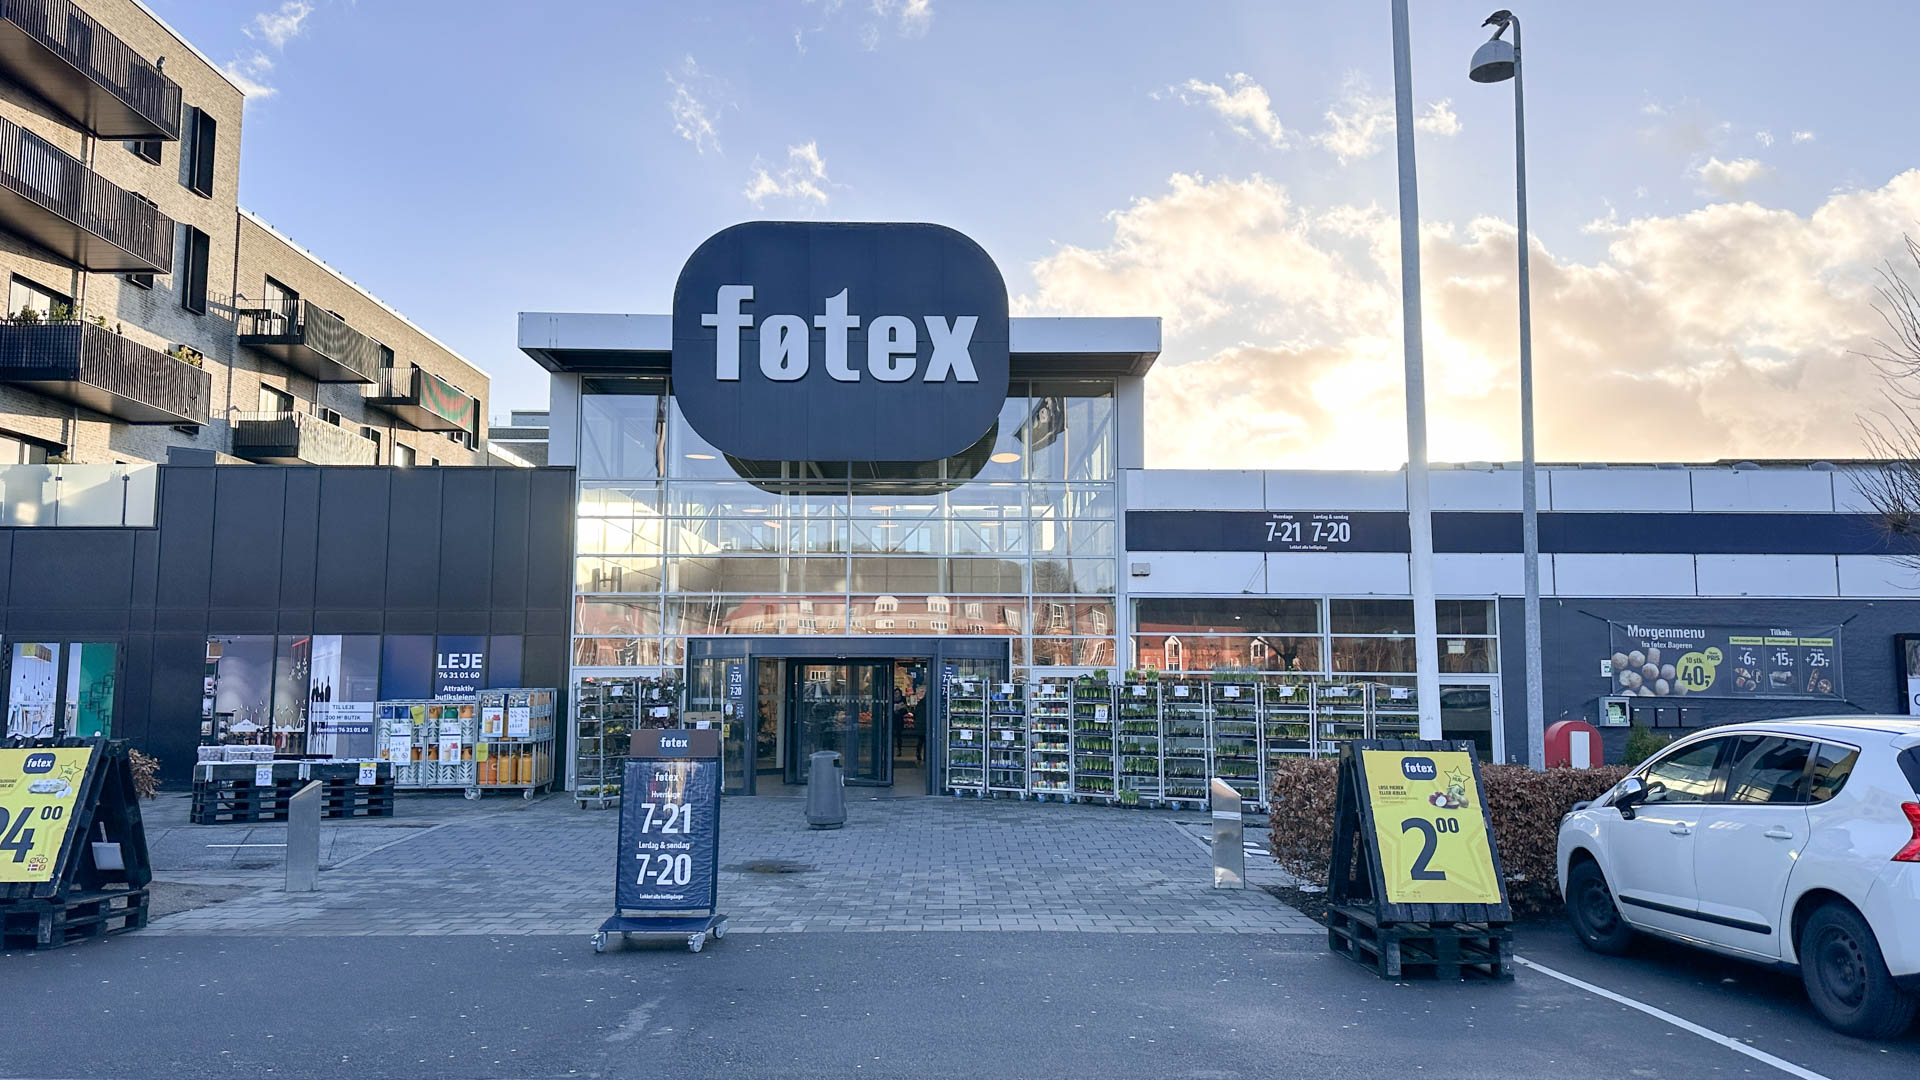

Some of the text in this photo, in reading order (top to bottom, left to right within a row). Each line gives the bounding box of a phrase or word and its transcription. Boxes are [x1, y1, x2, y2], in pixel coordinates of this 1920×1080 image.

[701, 284, 980, 382] føtex
[1265, 522, 1351, 543] 7-21 7-20
[1627, 625, 1706, 640] Morgenmenu
[1651, 641, 1667, 649] føtex
[1667, 642, 1693, 650] Bageren
[437, 653, 483, 669] LEJE
[730, 674, 742, 683] 7-21
[730, 686, 742, 696] 7-20
[660, 736, 688, 748] føtex
[27, 758, 52, 768] føtex
[1404, 763, 1434, 773] føtex
[655, 772, 679, 782] føtex
[651, 790, 681, 800] Hverdage
[641, 803, 692, 834] 7-21
[638, 841, 690, 850] Lørdag & søndag
[635, 853, 692, 886] 7-20
